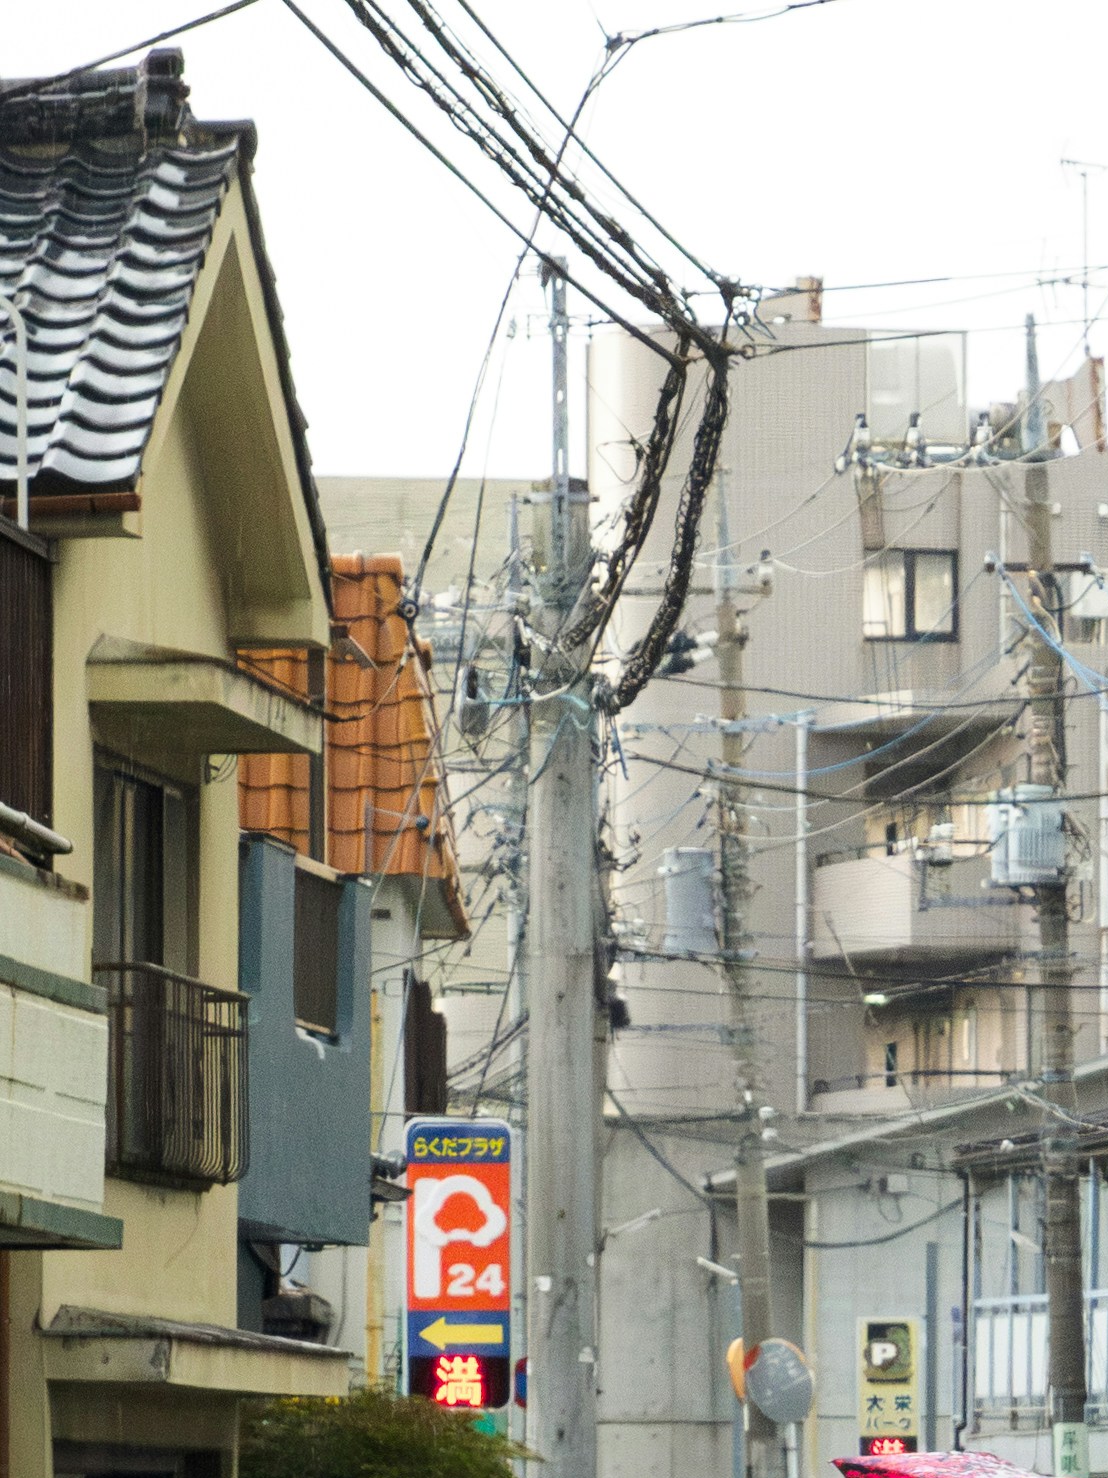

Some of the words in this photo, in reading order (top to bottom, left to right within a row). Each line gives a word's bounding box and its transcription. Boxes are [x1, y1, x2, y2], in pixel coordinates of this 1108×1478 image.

[413, 1137, 505, 1158] らくだプラザ
[447, 1263, 505, 1297] 24
[871, 1342, 897, 1366] P
[436, 1355, 483, 1406] 満
